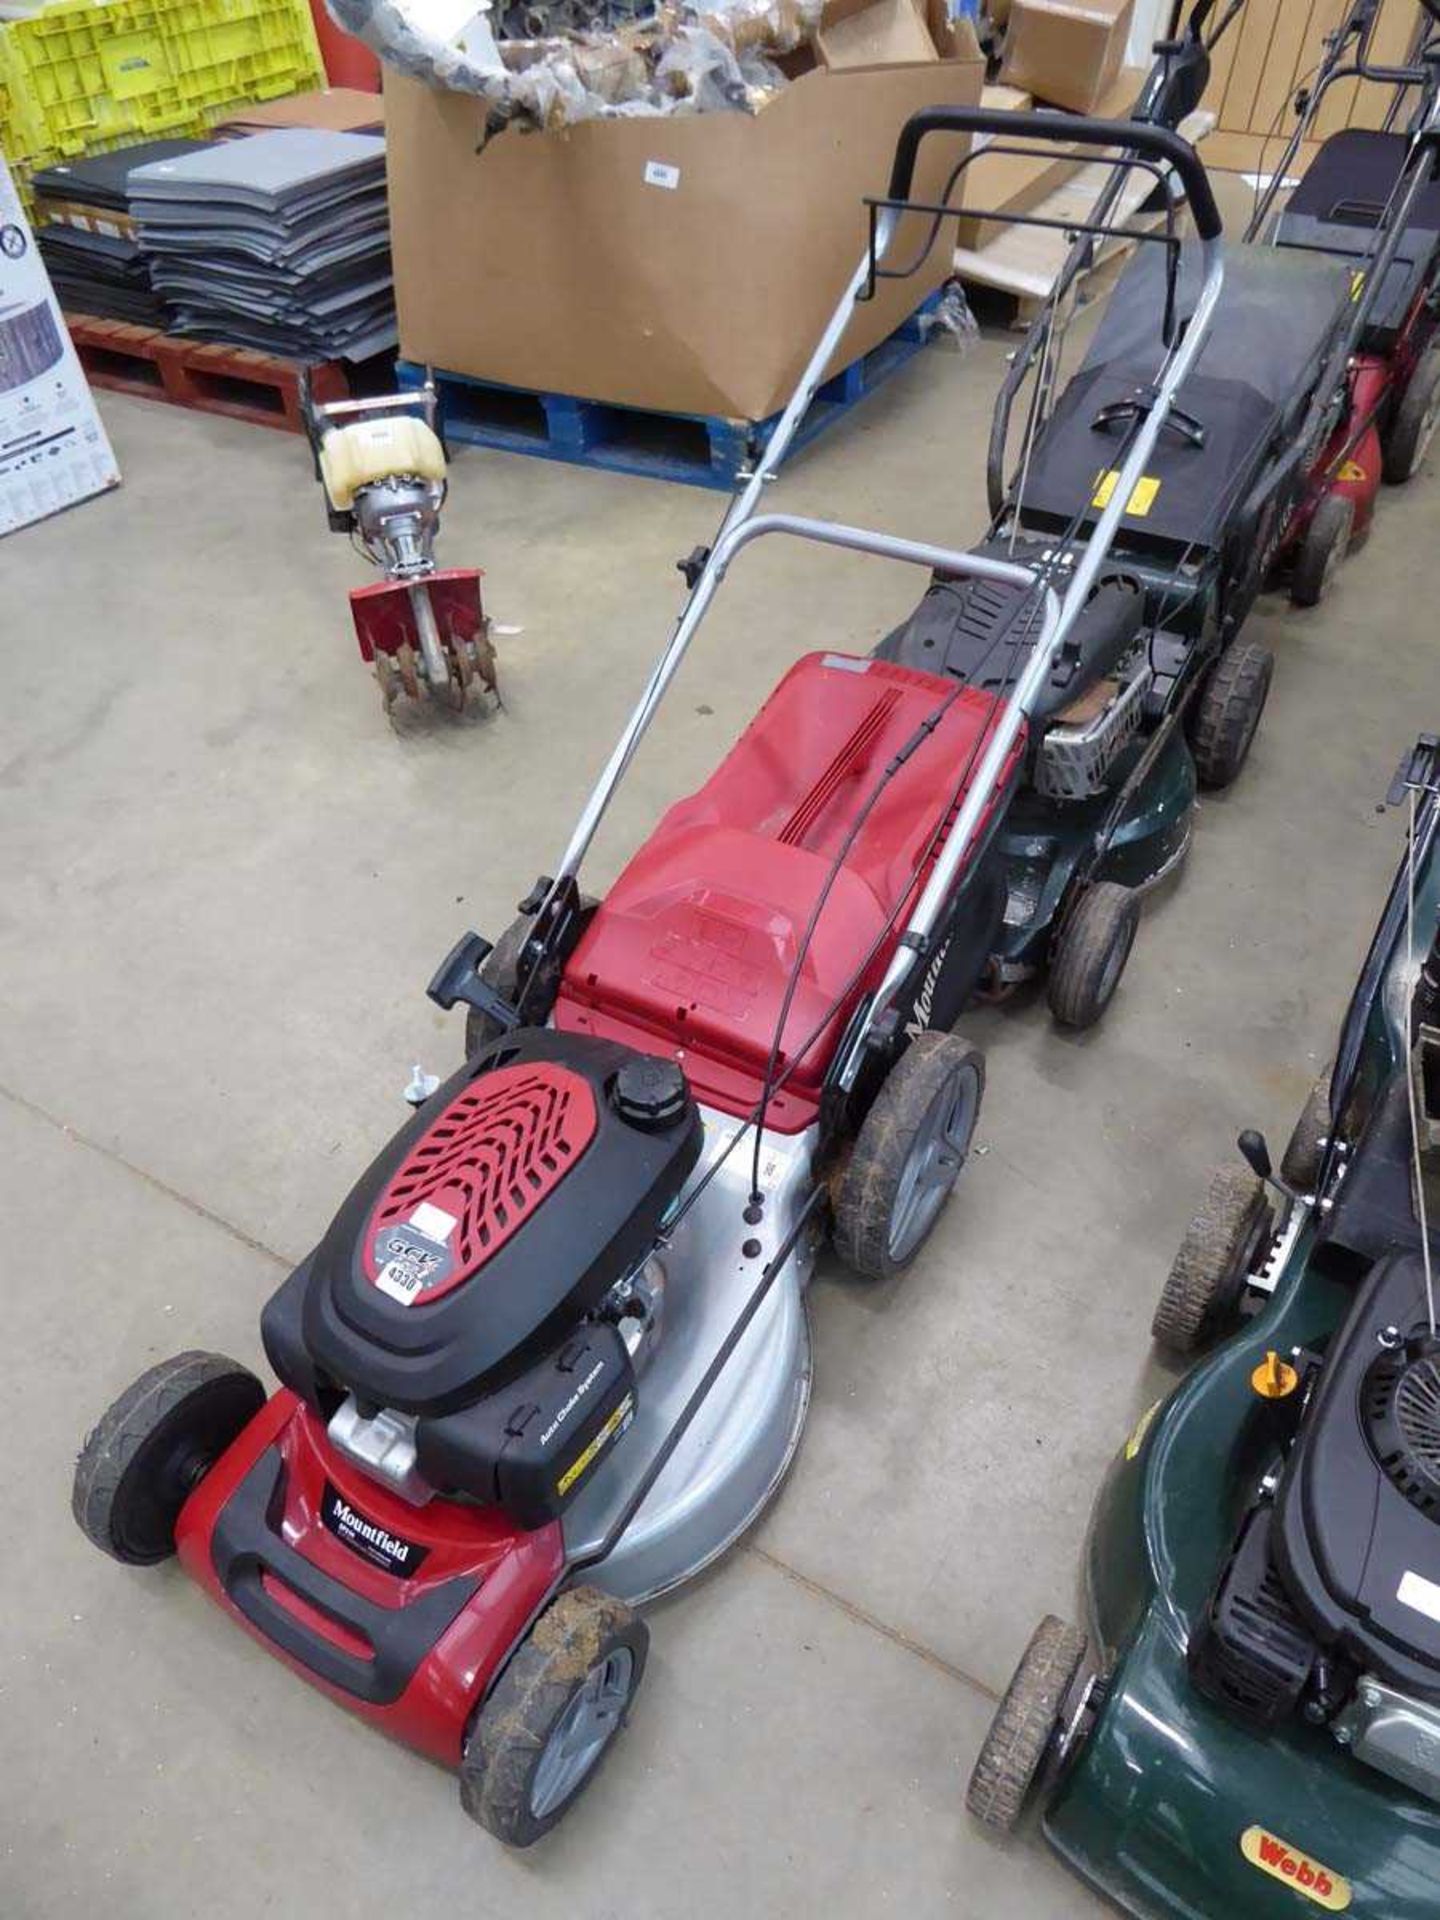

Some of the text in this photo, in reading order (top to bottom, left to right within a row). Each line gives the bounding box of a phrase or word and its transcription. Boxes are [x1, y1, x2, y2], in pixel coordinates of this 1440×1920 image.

[386, 1237, 441, 1264] GCV
[387, 1266, 418, 1292] 4330
[540, 1420, 559, 1445] Auto
[577, 1360, 605, 1395] System
[332, 1499, 409, 1562] Mountfield
[1259, 1835, 1333, 1896] Webb
